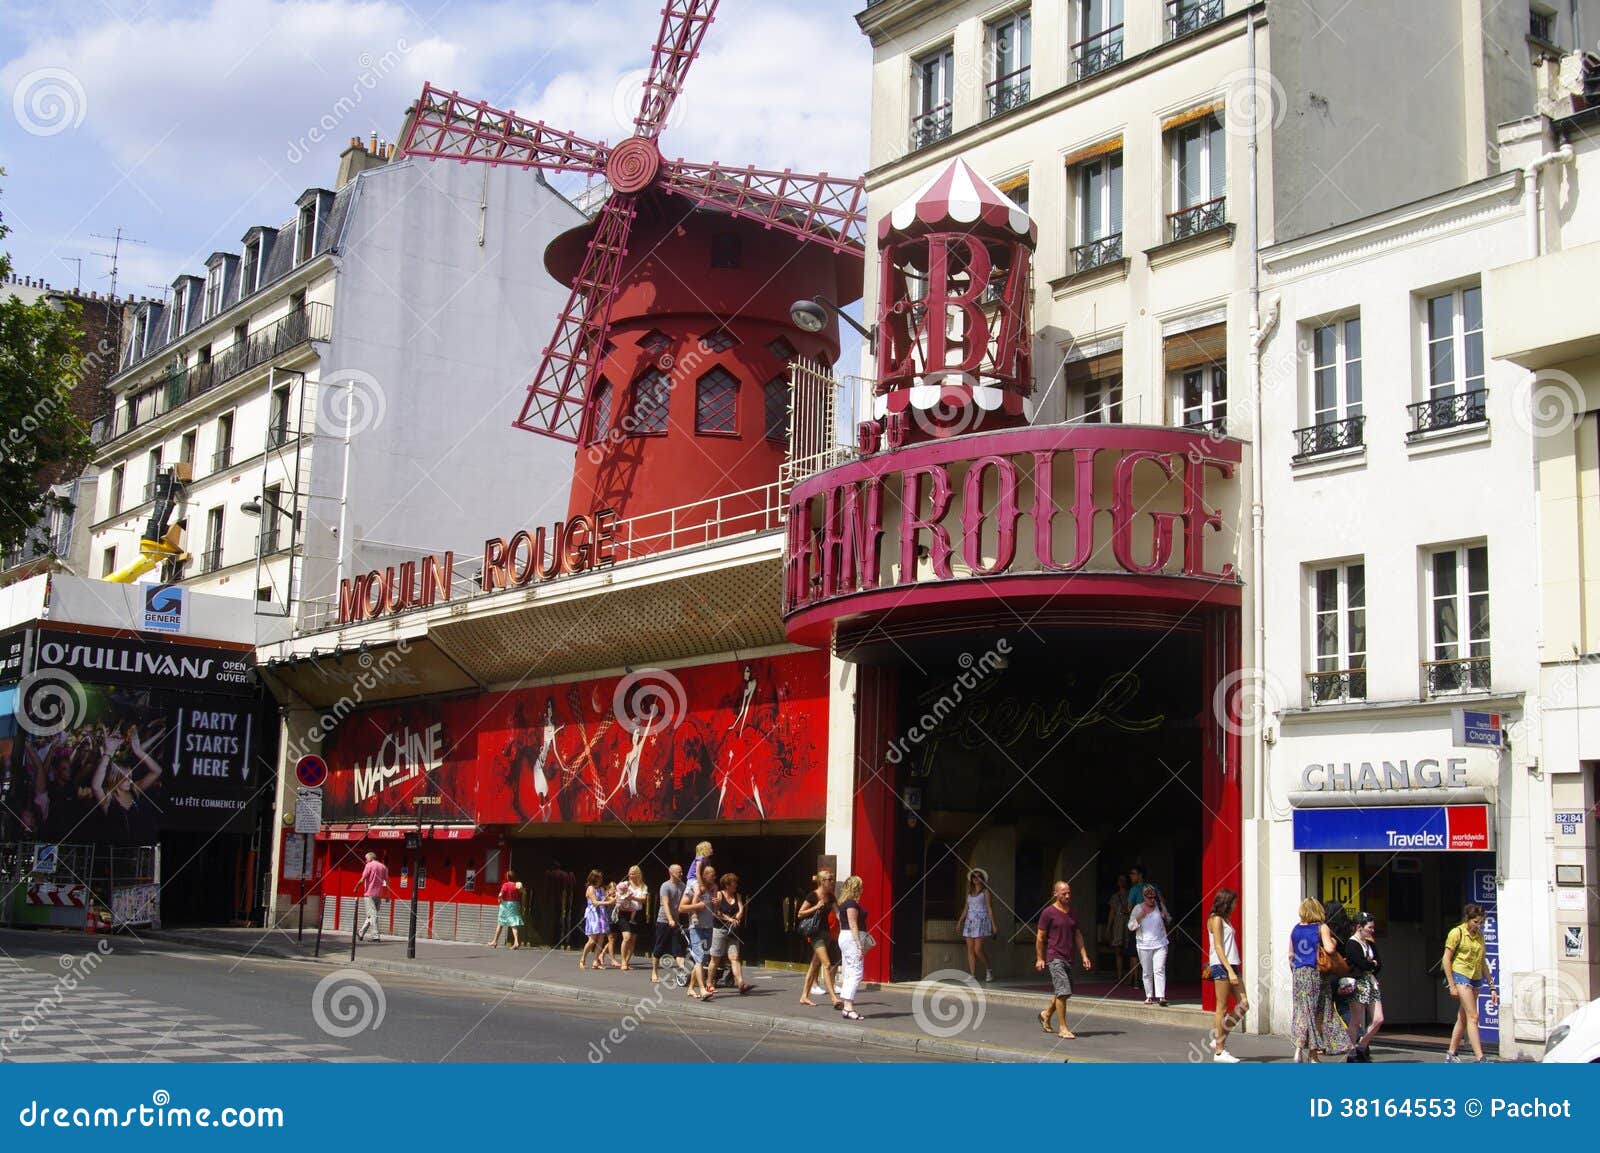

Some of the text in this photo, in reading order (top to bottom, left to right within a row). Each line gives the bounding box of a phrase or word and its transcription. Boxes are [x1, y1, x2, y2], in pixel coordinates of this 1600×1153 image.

[899, 447, 1237, 583] ROUGE
[338, 509, 616, 624] MOULIN ROUGE
[144, 613, 181, 624] GENERE
[41, 642, 214, 679] O'SULLIVANS
[222, 661, 247, 671] OPEN
[216, 672, 249, 683] OUVER
[191, 710, 238, 731] PARTY
[185, 733, 239, 755] STARTS
[1470, 730, 1496, 743] Change
[192, 757, 230, 777] HERE
[354, 722, 443, 804] MACHINE
[1302, 758, 1468, 791] CHANGE
[175, 797, 184, 806] LA
[201, 798, 235, 809] COMMENCE
[1386, 830, 1443, 846] Travelex
